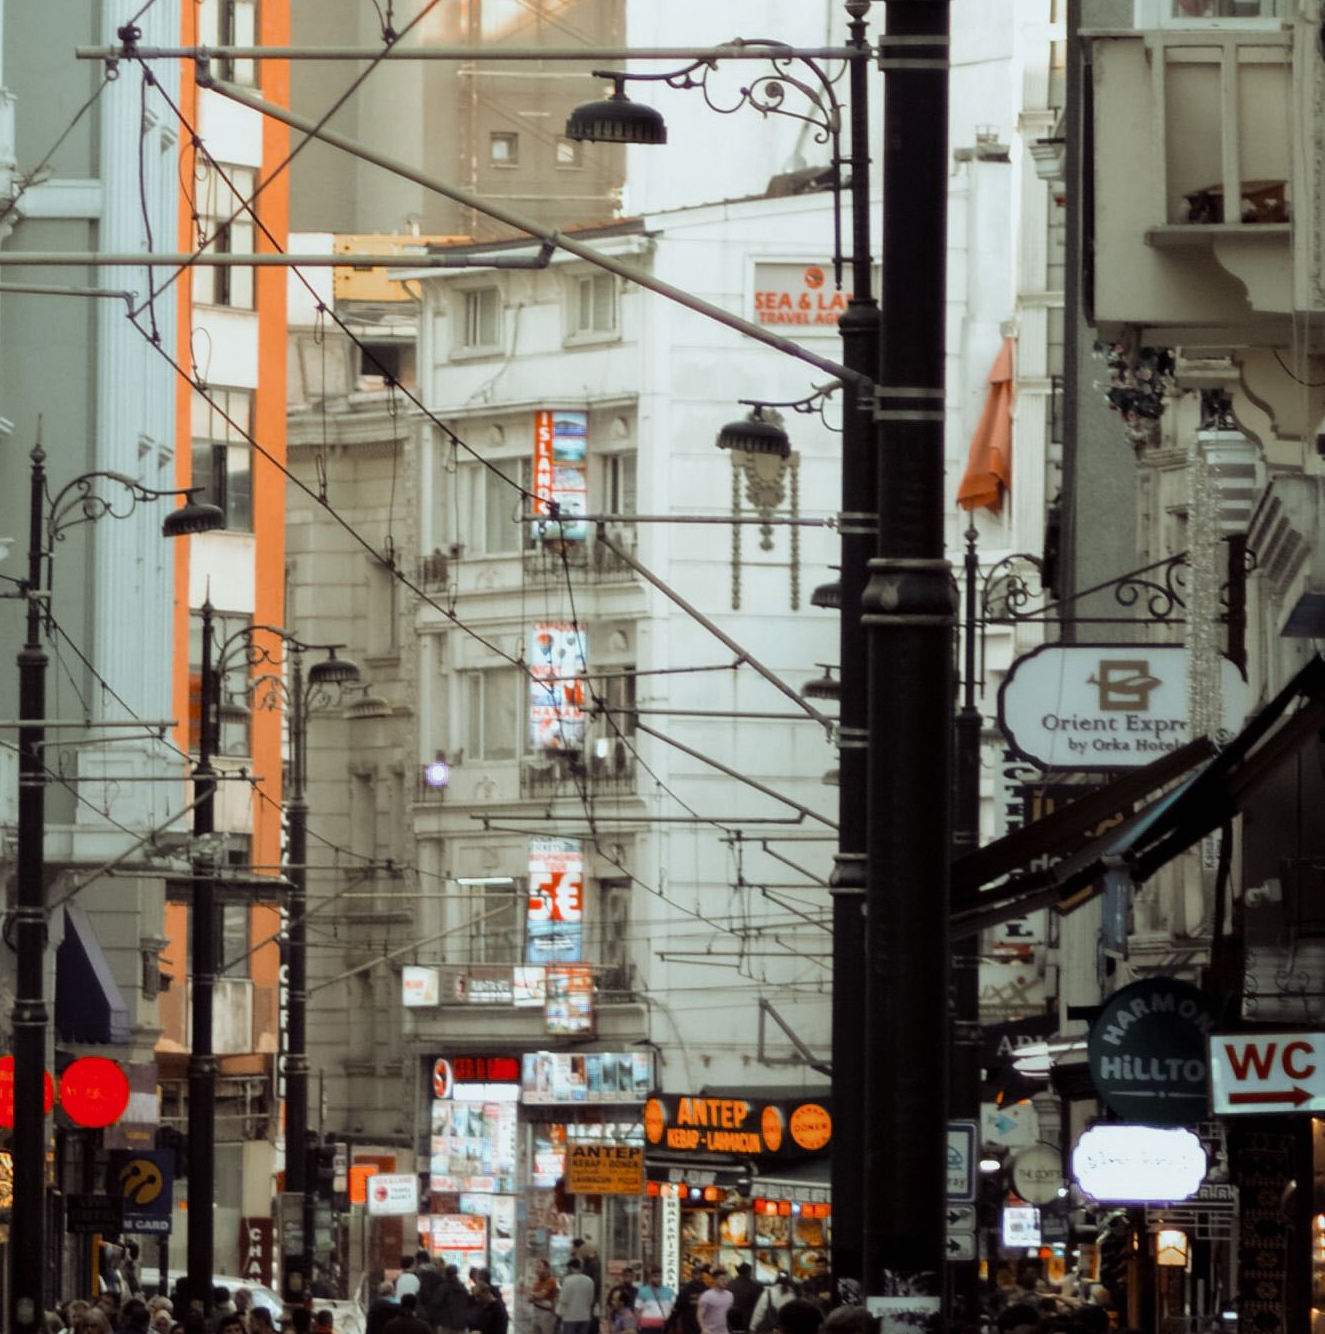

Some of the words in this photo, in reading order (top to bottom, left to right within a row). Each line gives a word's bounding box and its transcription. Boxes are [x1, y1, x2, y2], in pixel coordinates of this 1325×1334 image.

[755, 292, 792, 310] SEA
[798, 292, 812, 310] &
[759, 312, 809, 325] TRAVEL
[1042, 714, 1117, 732] Orient
[1068, 738, 1088, 755] by
[1092, 738, 1130, 752] Orka
[529, 871, 582, 921] 5€
[1224, 1040, 1317, 1081] WC
[678, 1097, 749, 1129] ANTEP
[667, 1128, 700, 1150] KEBAP
[572, 1146, 640, 1158] ANTEP
[135, 1219, 169, 1230] CARD
